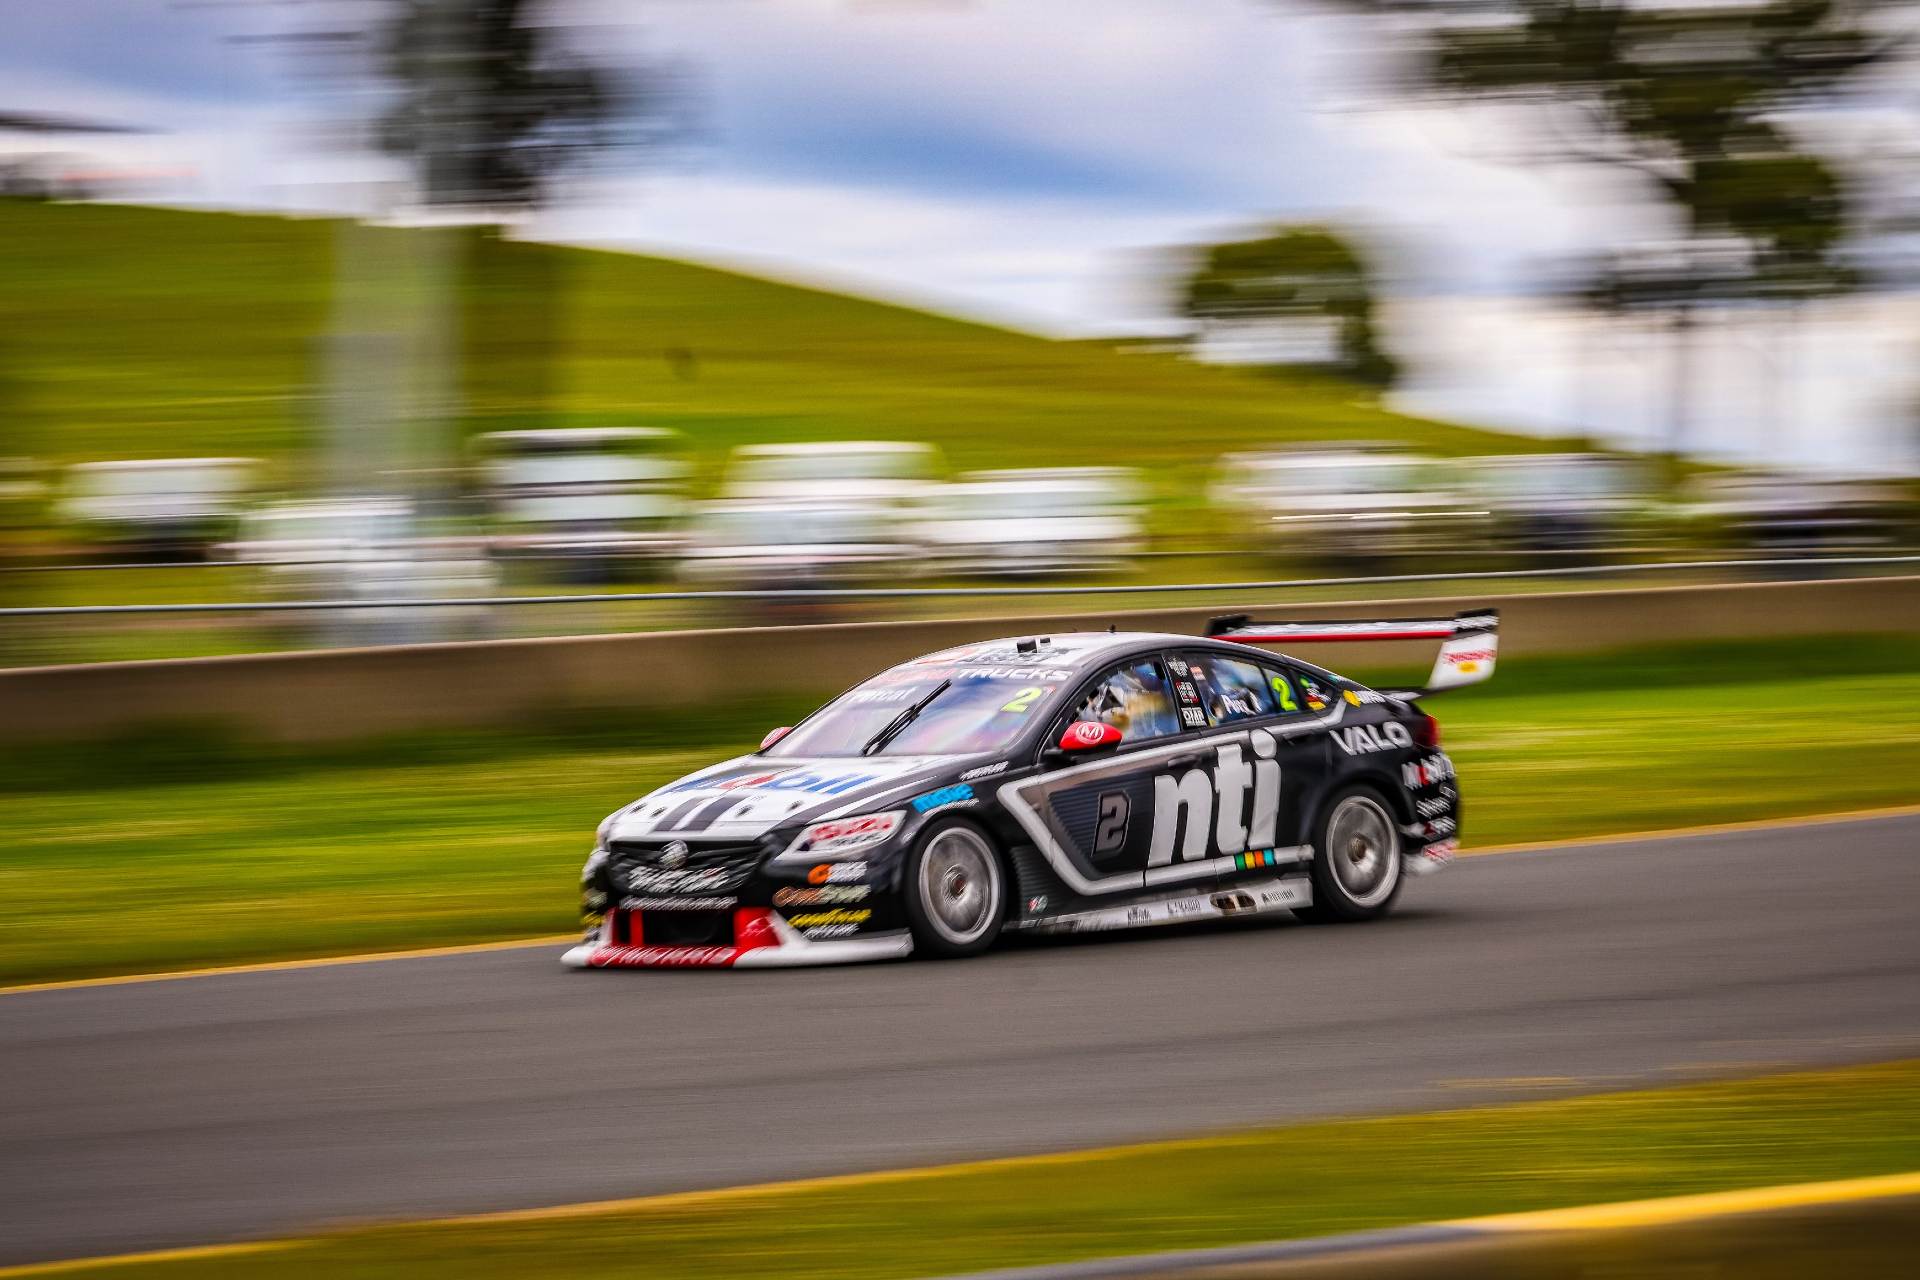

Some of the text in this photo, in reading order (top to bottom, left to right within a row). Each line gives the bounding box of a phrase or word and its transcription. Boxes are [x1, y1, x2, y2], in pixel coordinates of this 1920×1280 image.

[957, 668, 1074, 681] TRUCKS
[1001, 687, 1043, 712] 2
[1271, 677, 1298, 711] 2
[1329, 721, 1414, 756] VALO
[1147, 729, 1281, 867] nti
[1092, 791, 1131, 854] 2
